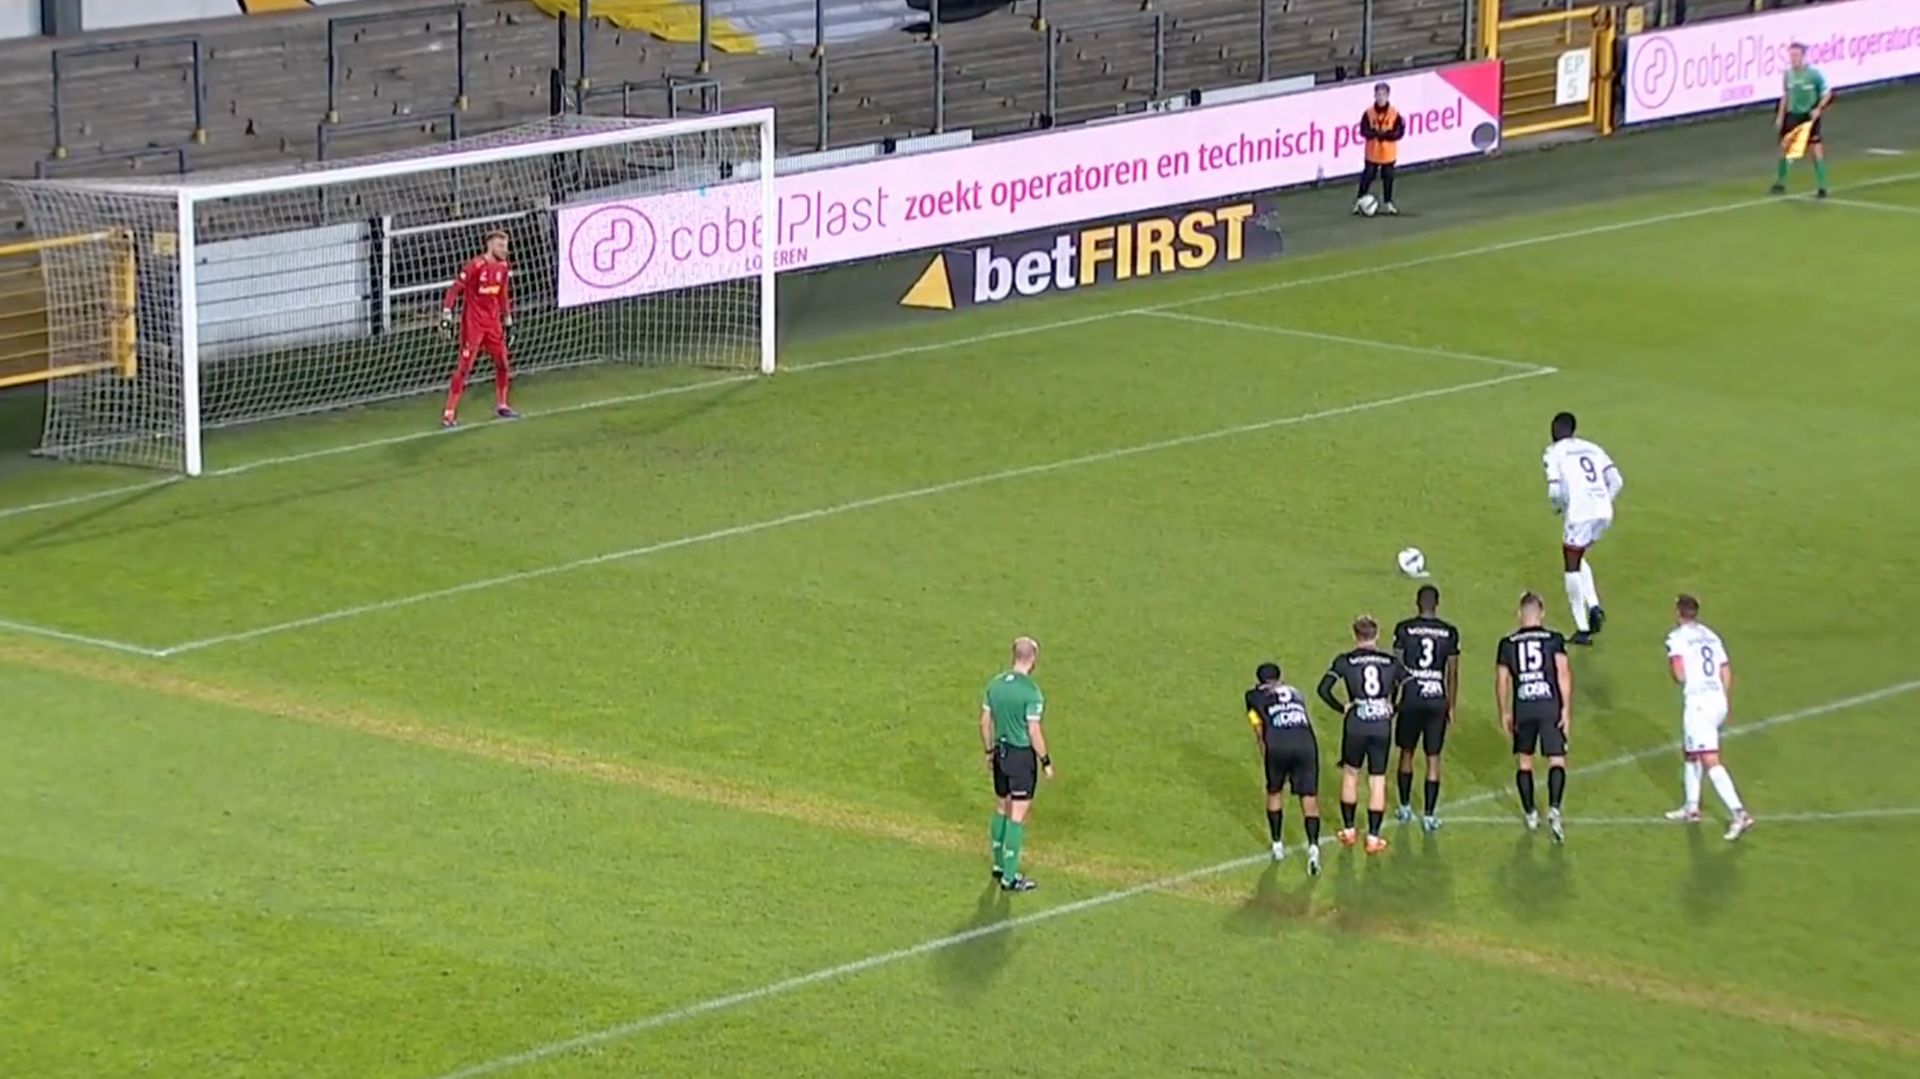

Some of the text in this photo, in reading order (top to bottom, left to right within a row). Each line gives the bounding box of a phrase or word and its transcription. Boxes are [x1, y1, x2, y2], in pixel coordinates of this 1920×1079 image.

[1564, 55, 1585, 74] EP
[1683, 34, 1796, 90] cobelPlas
[1566, 77, 1578, 99] 5
[904, 179, 983, 221] zoekt
[990, 156, 1148, 214] operatoren
[1157, 150, 1189, 178] en
[1198, 121, 1325, 172] technisch
[1334, 97, 1462, 159] peneel
[745, 246, 808, 272] LOEREN
[973, 203, 1254, 304] betFIRST
[1579, 456, 1597, 483] 9
[1419, 637, 1434, 669] 3
[1518, 640, 1543, 672] 15
[1700, 645, 1715, 677] 8
[1364, 665, 1381, 697] 8
